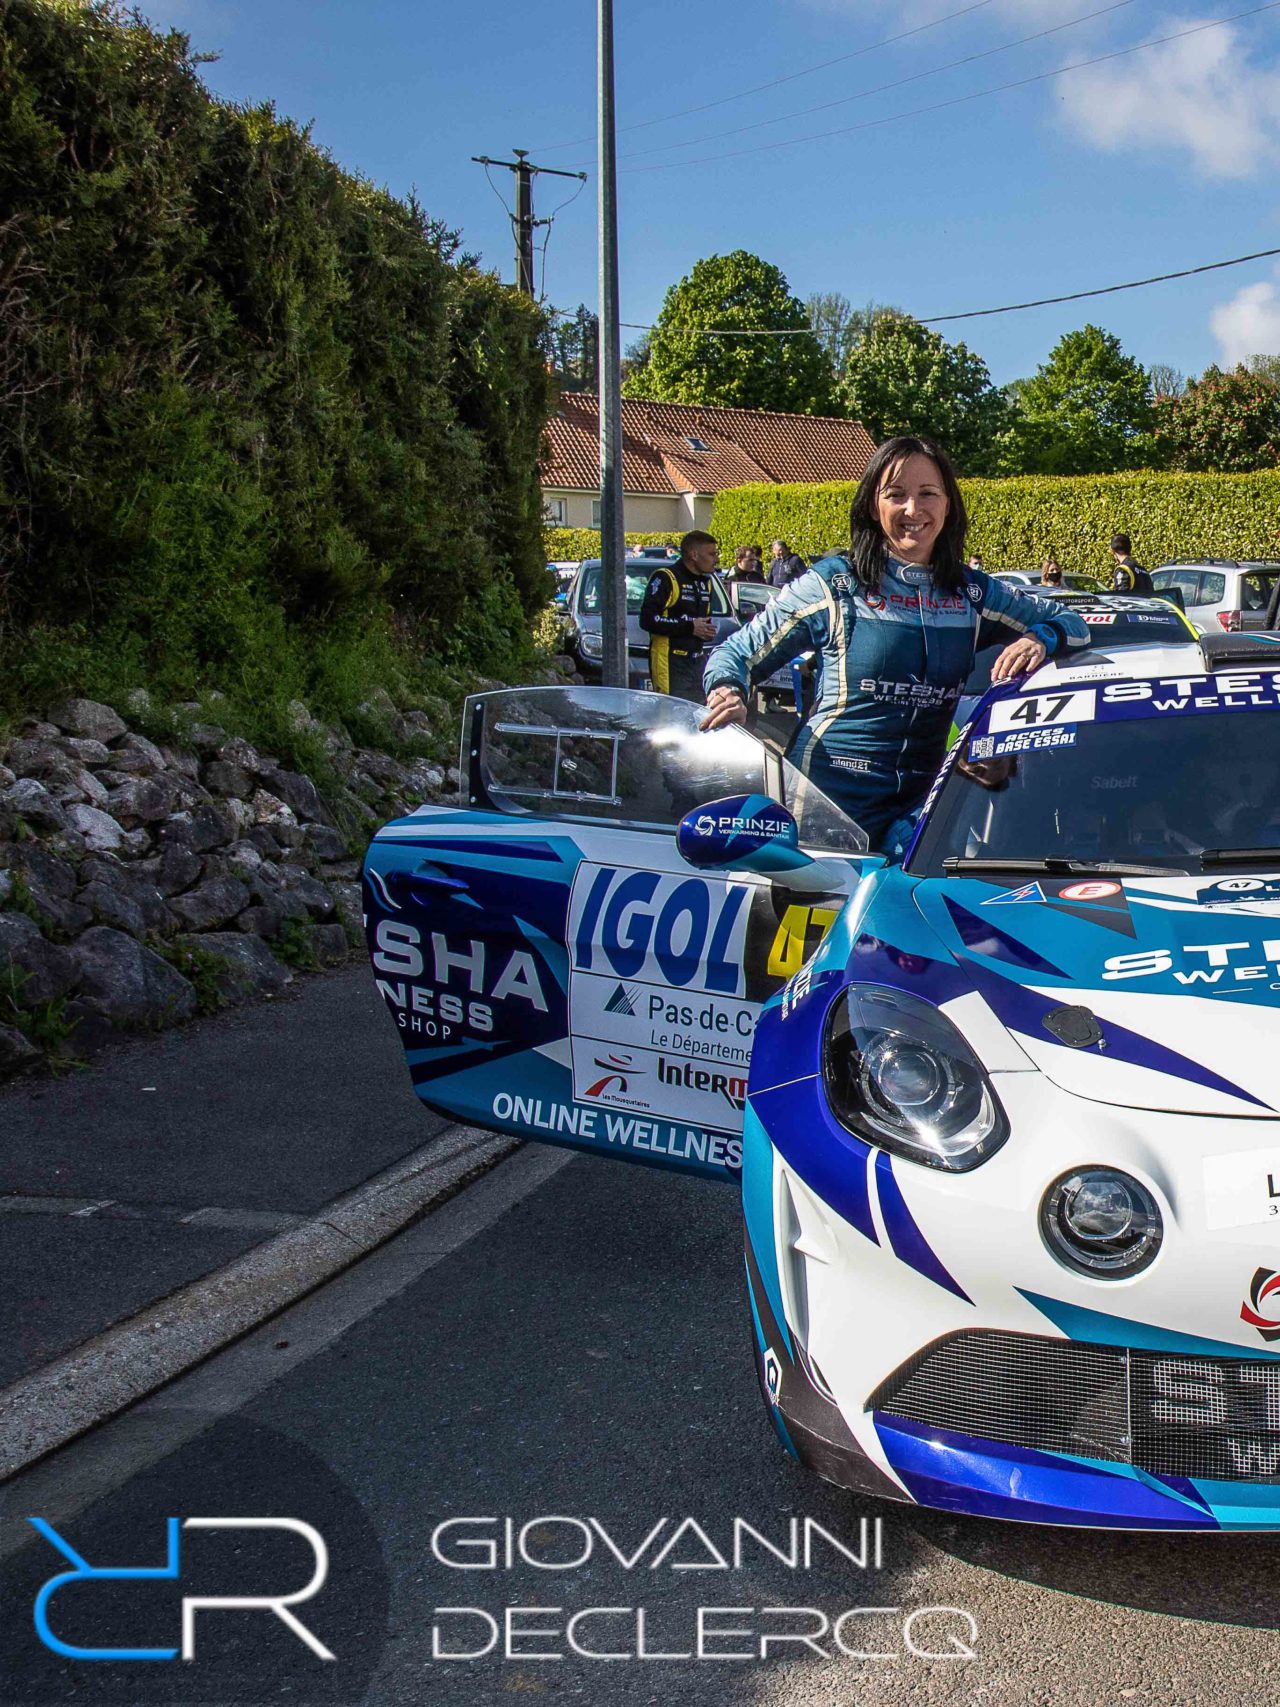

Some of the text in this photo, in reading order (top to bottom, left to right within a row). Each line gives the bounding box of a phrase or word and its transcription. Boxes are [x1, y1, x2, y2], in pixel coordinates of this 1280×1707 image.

[1009, 694, 1076, 725] 47
[995, 732, 1076, 755] BASE ESSAI
[1005, 727, 1065, 742] ACCES
[1091, 776, 1138, 790] Sabelt
[718, 817, 790, 834] PRINZIE
[1083, 886, 1102, 896] E
[574, 868, 749, 993] IGOL
[373, 919, 549, 1013] SHA
[375, 979, 495, 1032] NESS
[649, 994, 758, 1037] Pas-de-C
[398, 1013, 451, 1040] SHOP
[650, 1030, 752, 1063] Le Départeme
[658, 1056, 749, 1110] Interm
[492, 1093, 743, 1170] ONLINE WELLNES
